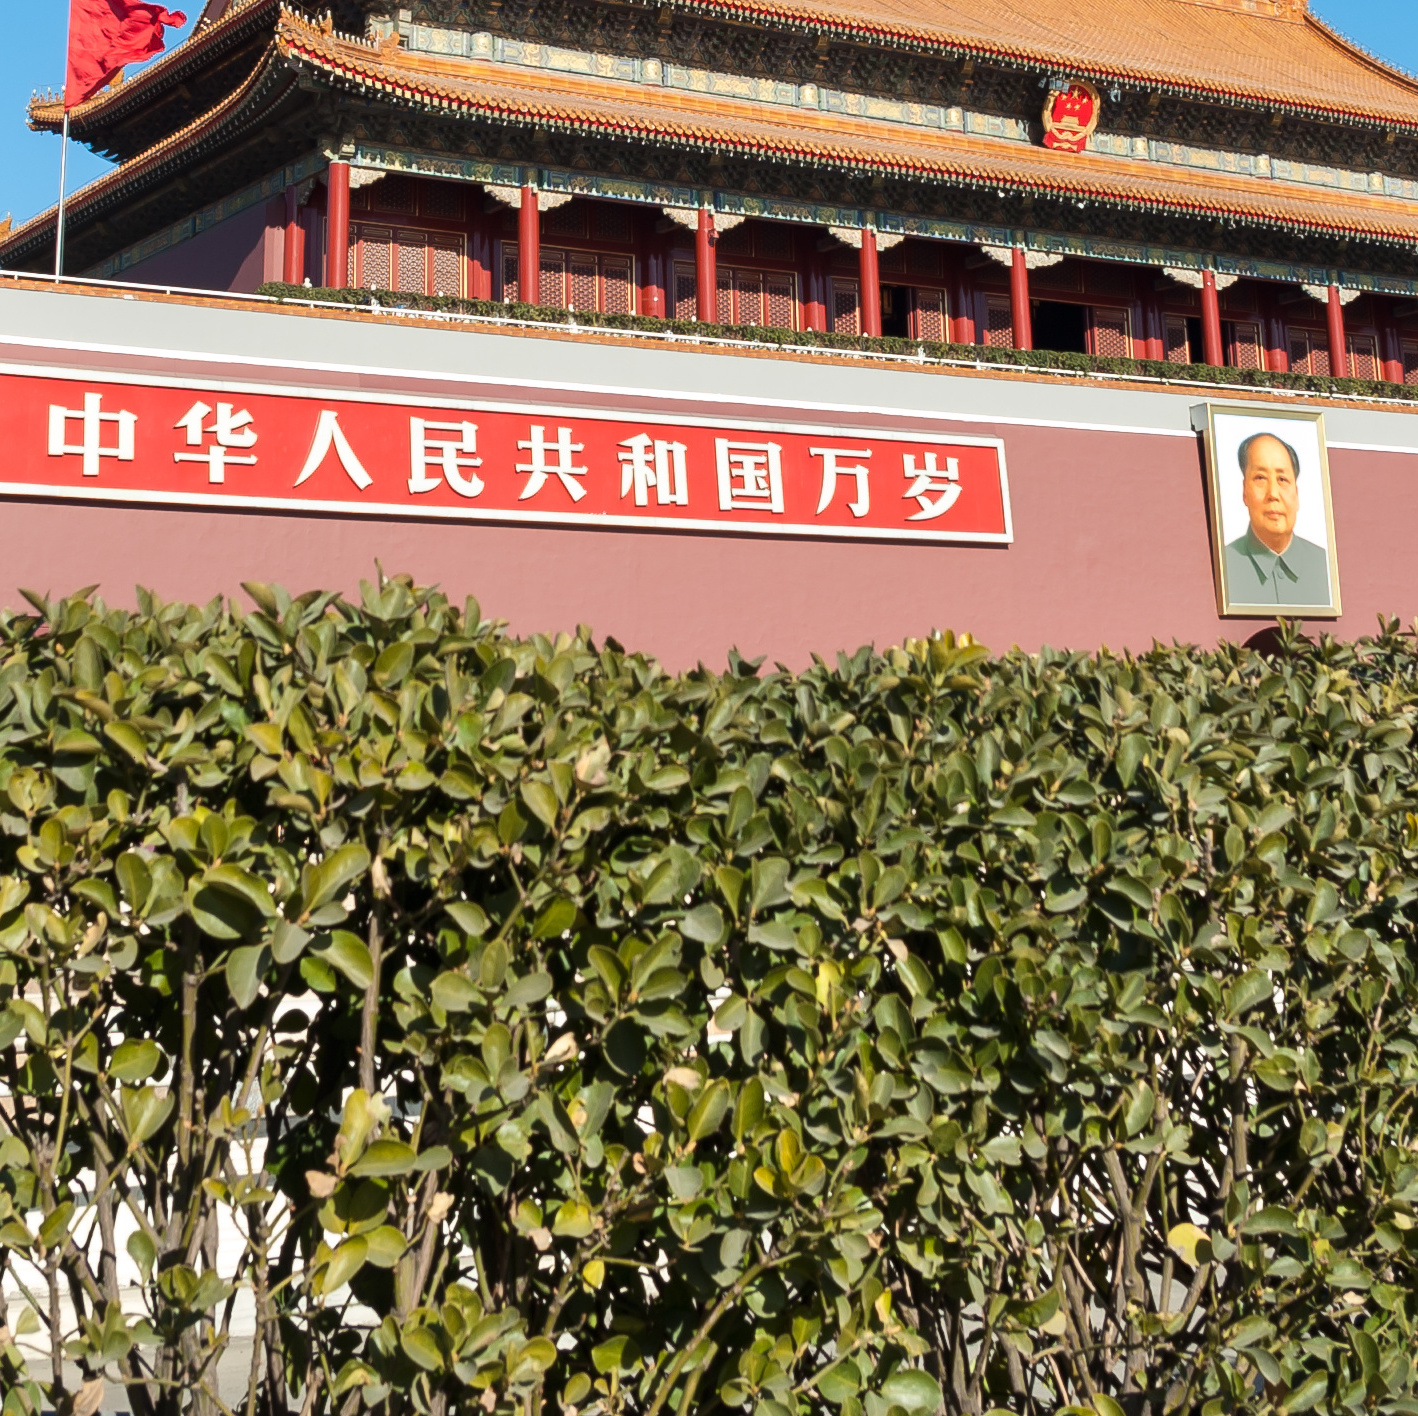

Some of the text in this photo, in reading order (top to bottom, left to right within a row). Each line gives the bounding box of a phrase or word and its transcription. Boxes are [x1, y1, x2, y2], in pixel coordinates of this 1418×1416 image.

[46, 391, 963, 521] 中华人民共和国万岁
